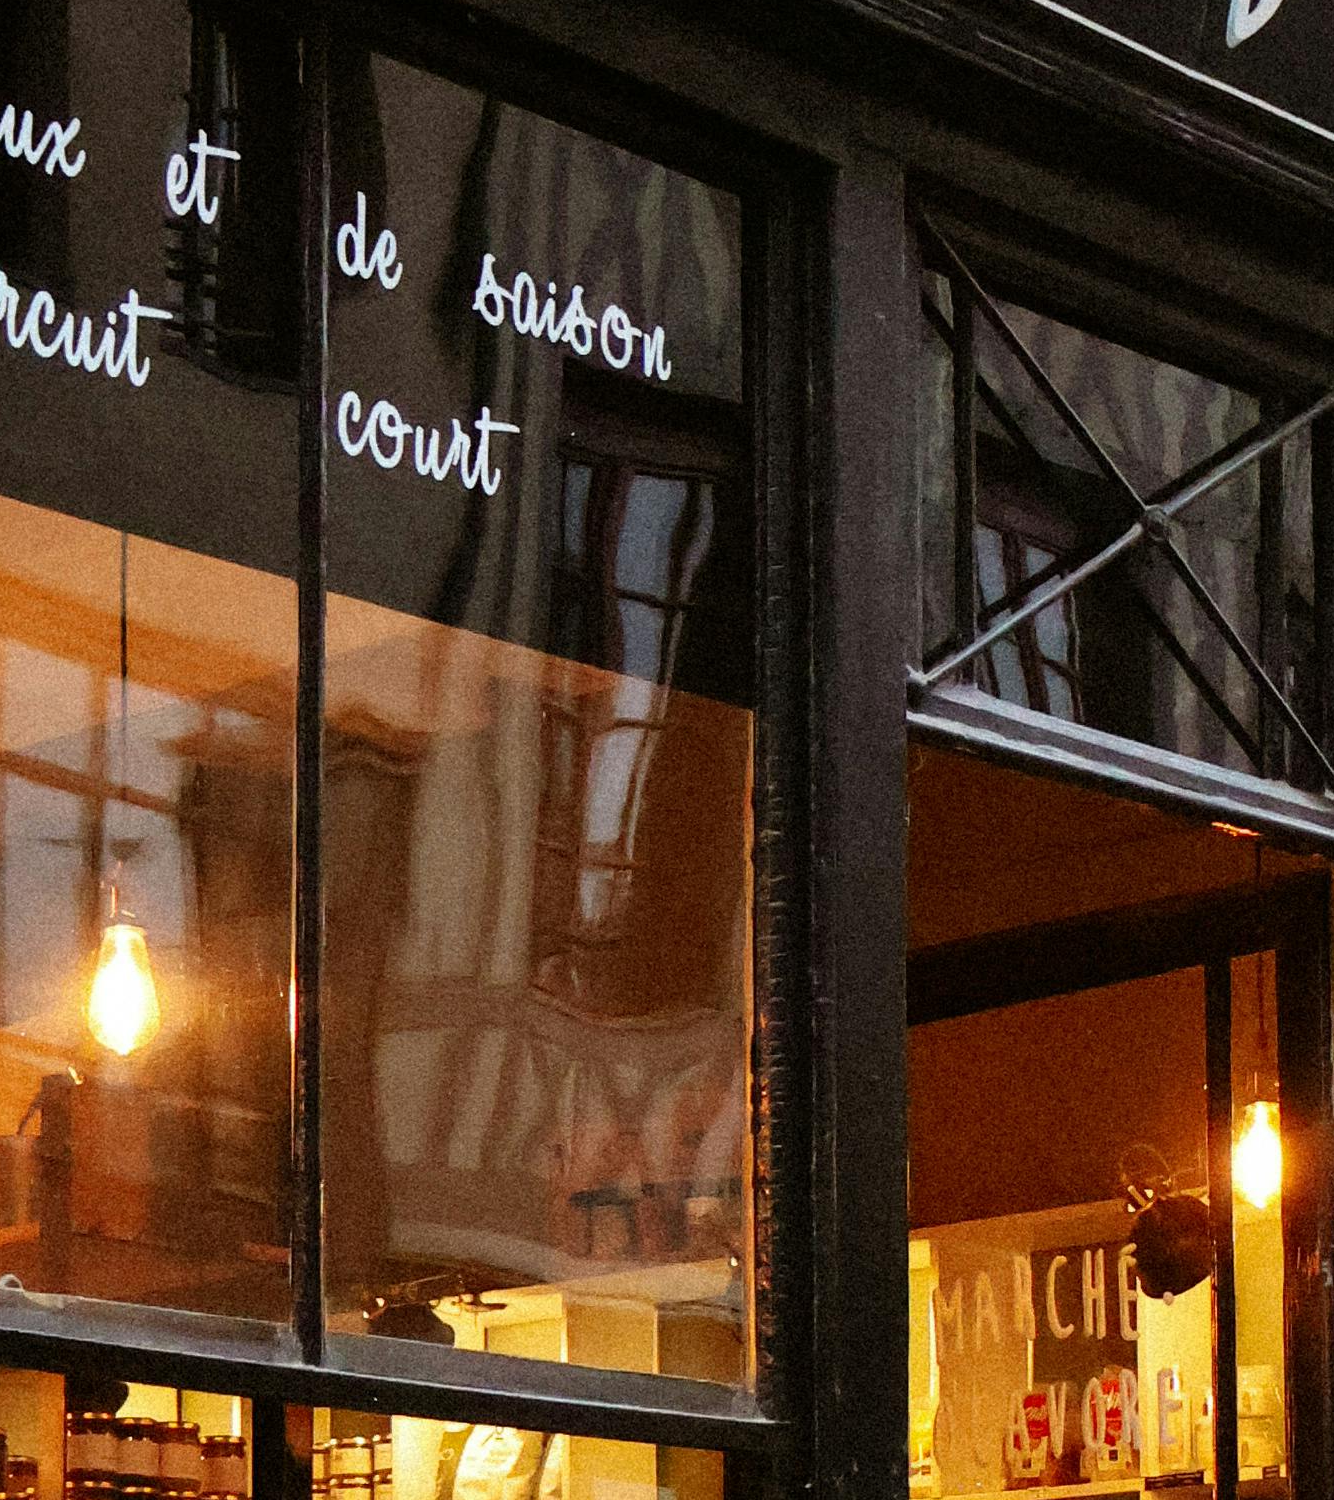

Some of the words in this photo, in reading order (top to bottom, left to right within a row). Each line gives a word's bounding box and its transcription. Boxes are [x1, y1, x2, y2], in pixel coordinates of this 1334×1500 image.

[166, 129, 241, 224] et
[337, 191, 403, 290] de
[472, 253, 672, 381] saison
[337, 390, 520, 496] court
